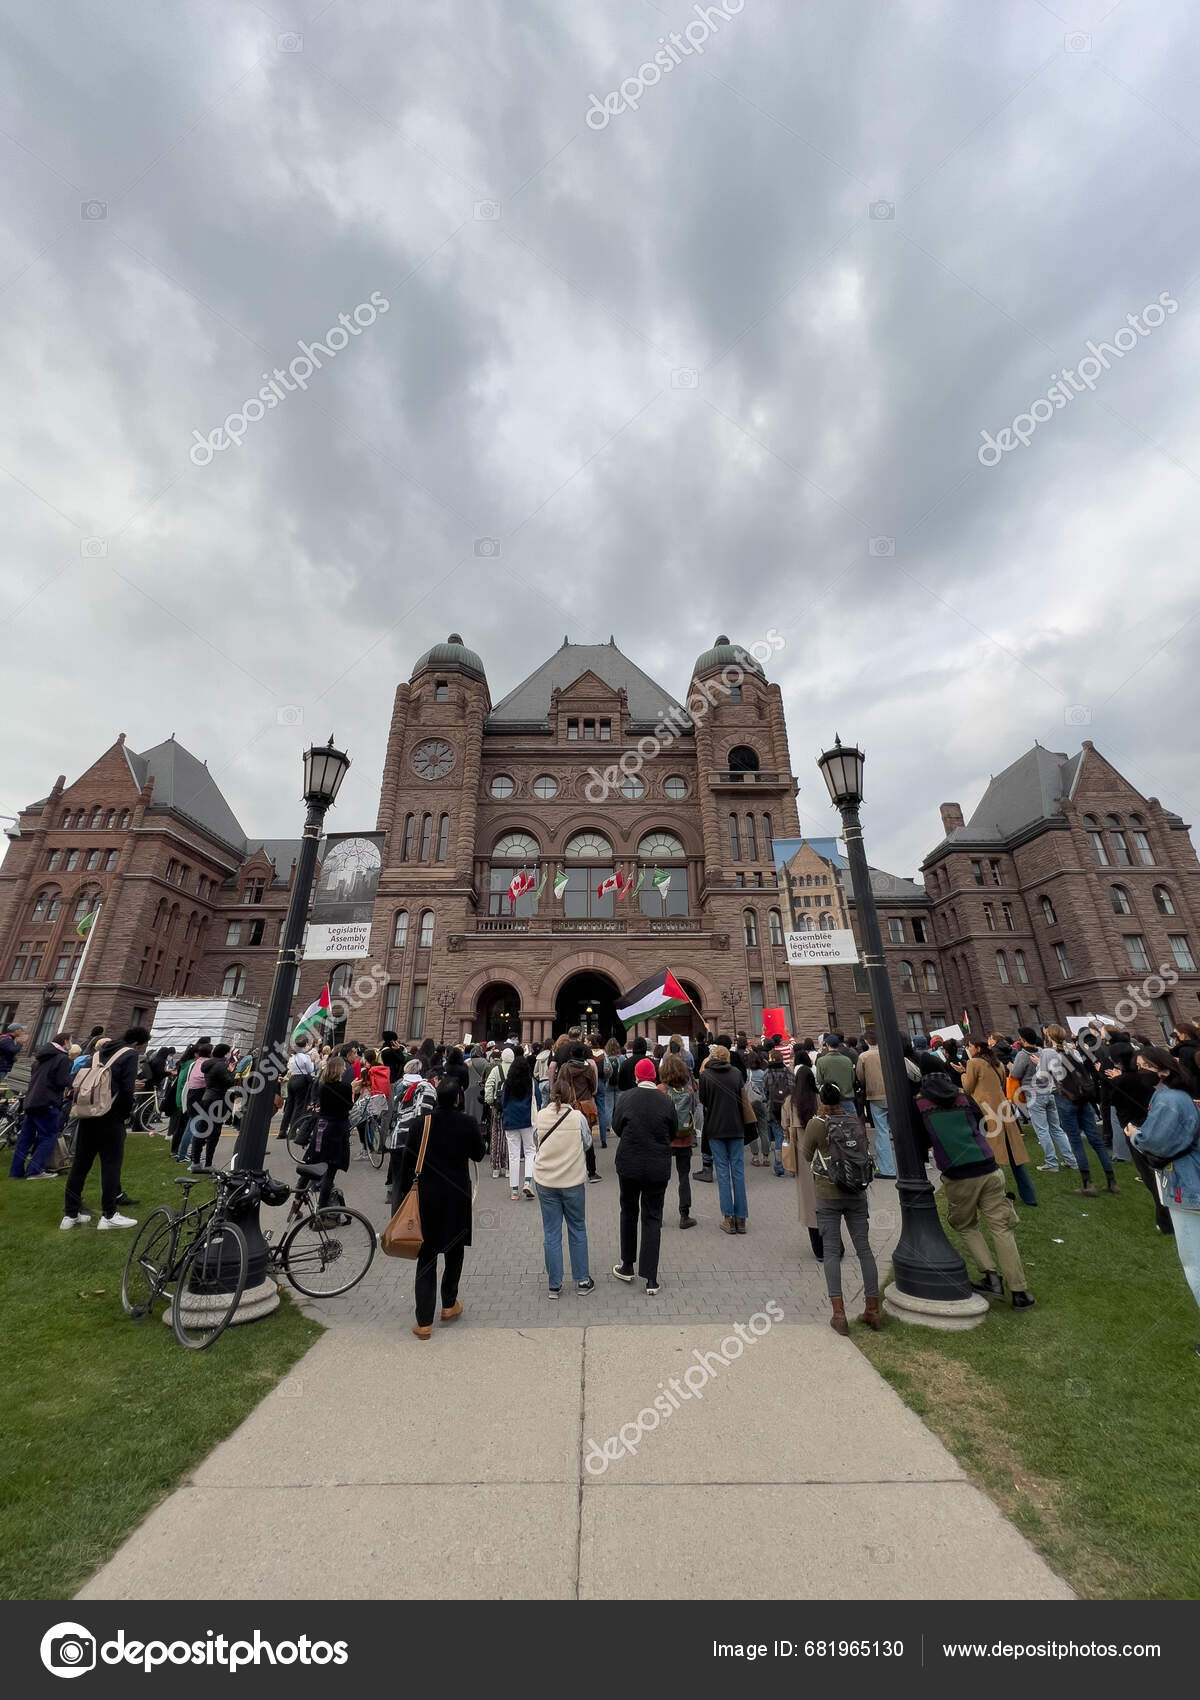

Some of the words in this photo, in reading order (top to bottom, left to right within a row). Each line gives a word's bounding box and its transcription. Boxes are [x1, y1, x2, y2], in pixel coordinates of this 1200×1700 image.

[328, 926, 367, 935] Legislative
[330, 935, 366, 943] Assembly
[789, 933, 832, 941] Assemblée
[336, 943, 365, 951] Ontario
[790, 942, 831, 950] législative
[803, 949, 840, 958] l'Ontario
